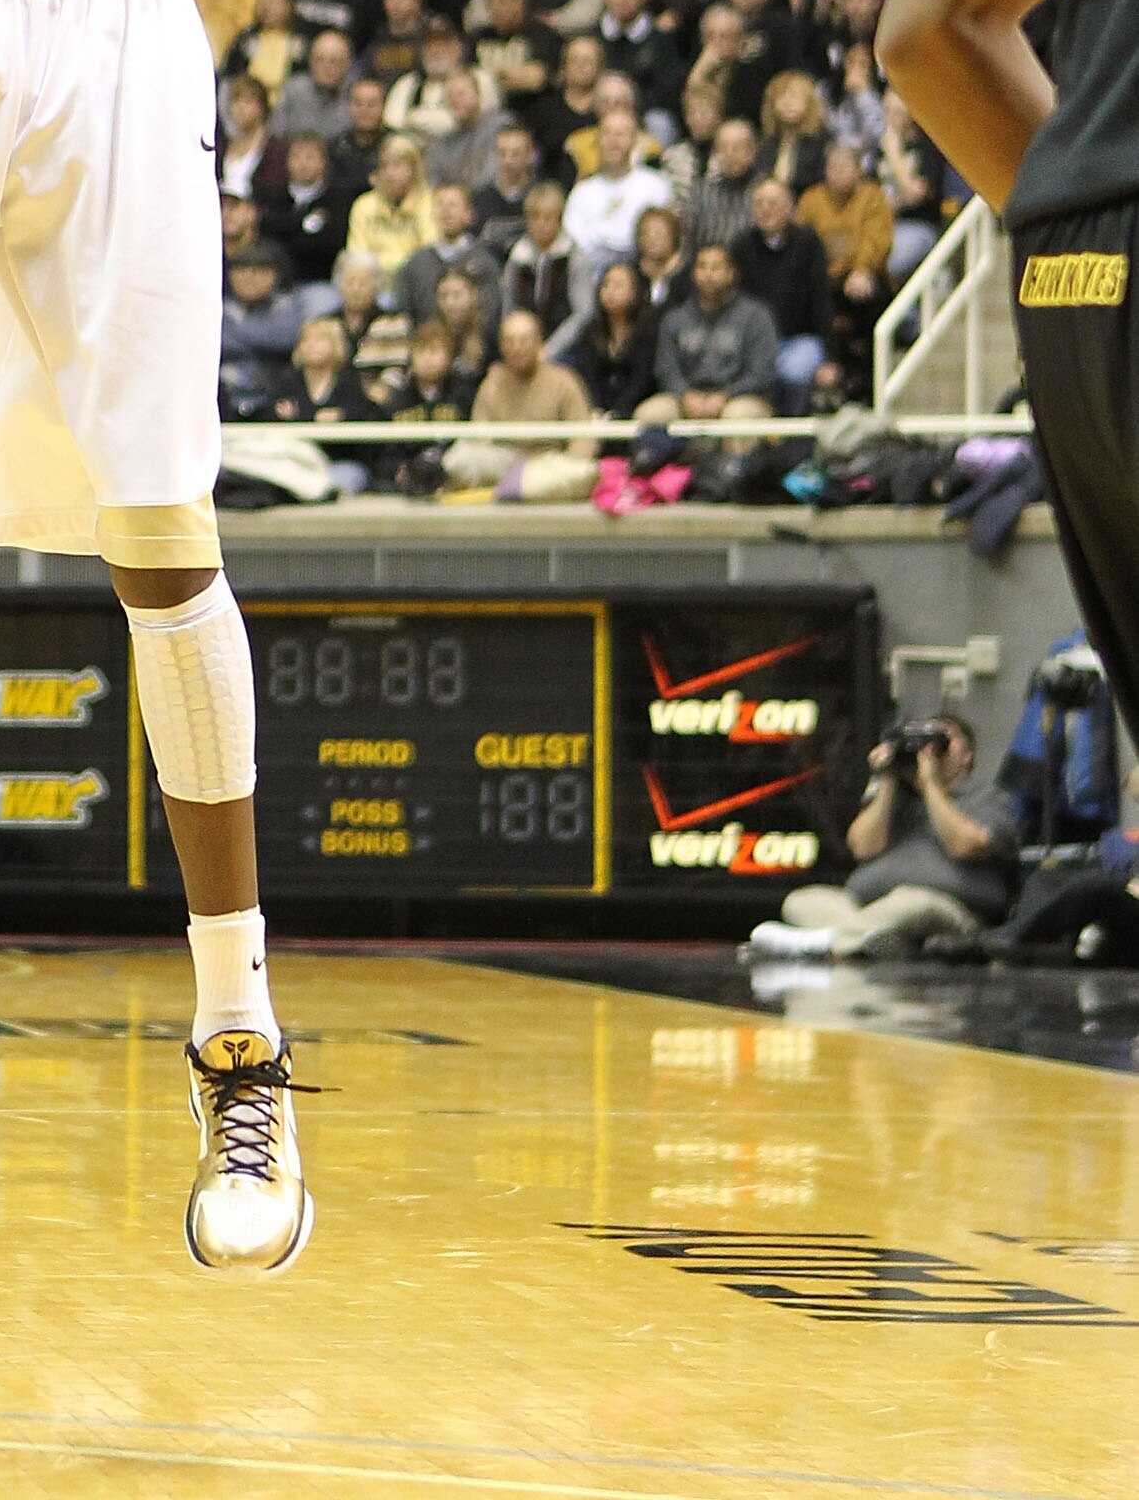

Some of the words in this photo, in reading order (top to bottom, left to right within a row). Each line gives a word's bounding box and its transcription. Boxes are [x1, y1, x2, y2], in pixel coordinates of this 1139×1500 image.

[649, 689, 819, 743] verizon
[318, 738, 415, 768] PERIOD
[474, 732, 589, 769] GUEST
[329, 799, 404, 826] POSS
[319, 827, 411, 856] BONUS
[649, 821, 819, 875] verizon
[551, 1221, 1139, 1327] KEADY
